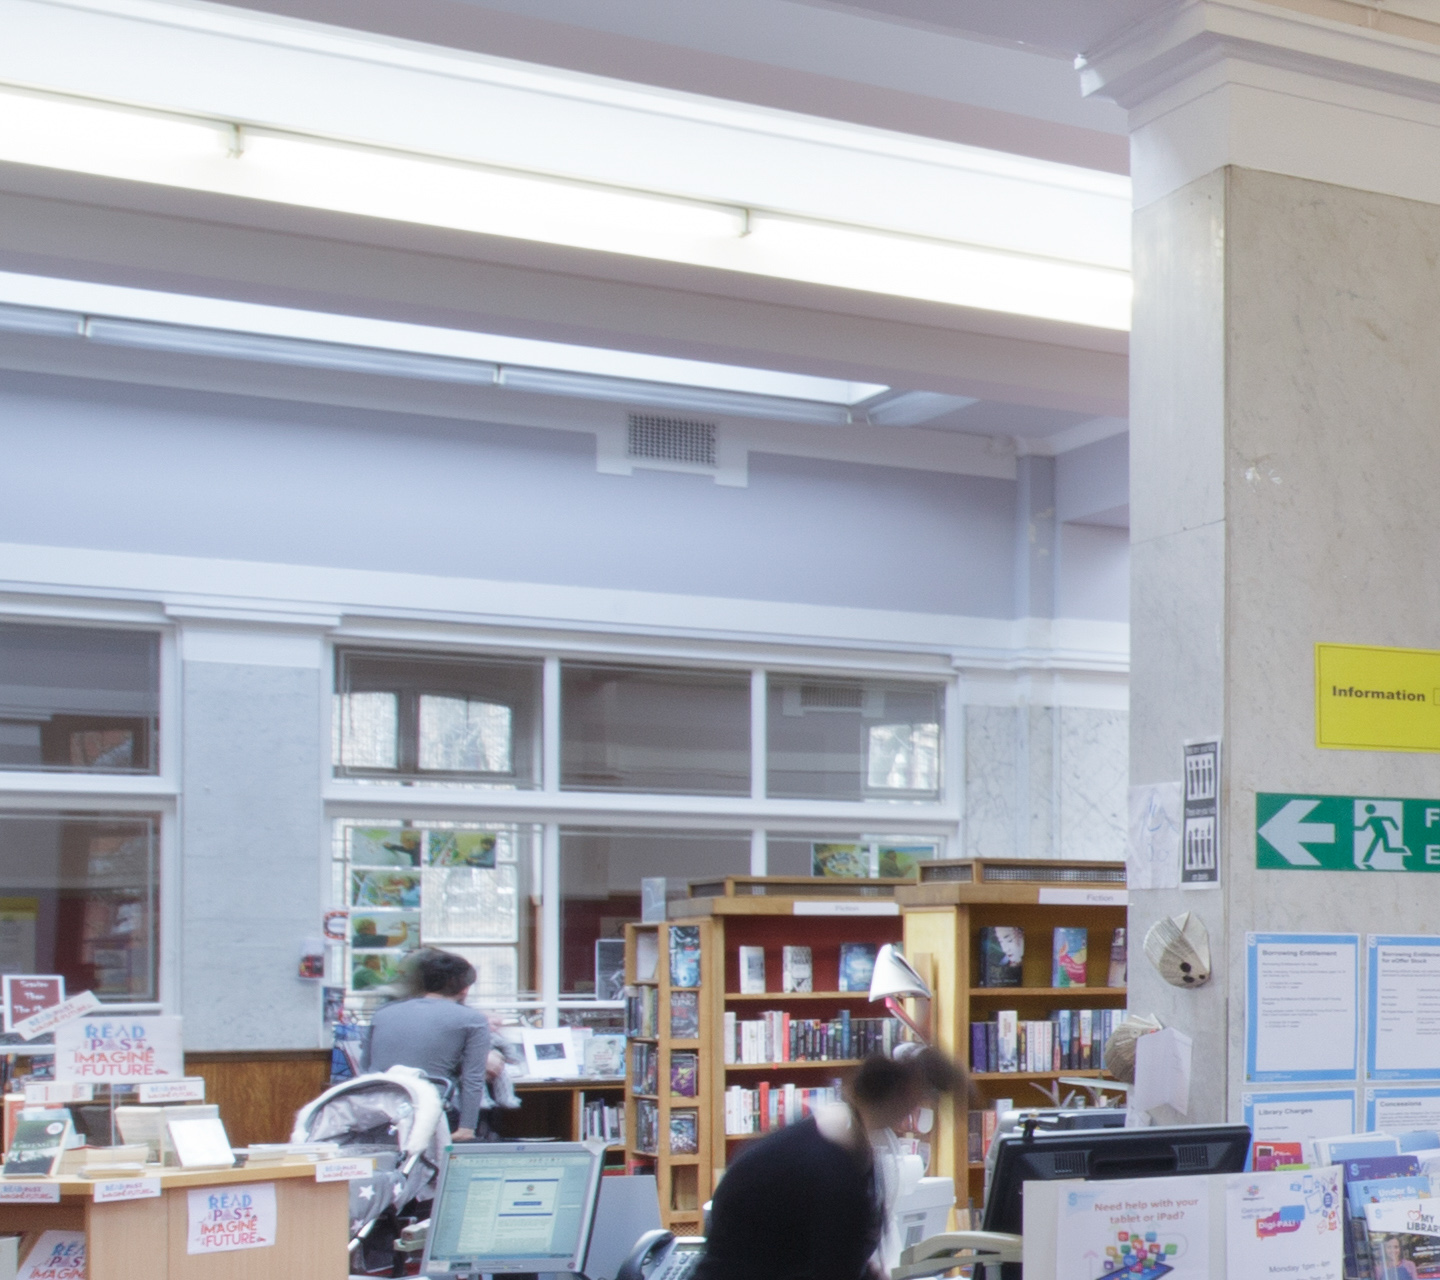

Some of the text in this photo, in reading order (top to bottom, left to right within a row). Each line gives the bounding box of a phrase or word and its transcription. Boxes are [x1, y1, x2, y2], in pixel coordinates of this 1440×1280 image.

[1331, 685, 1426, 703] Information
[1087, 894, 1114, 902] Fiction
[1262, 950, 1298, 958] Borrowing
[85, 1023, 145, 1039] READ
[74, 1051, 155, 1064] IMAGINE
[82, 1064, 153, 1076] FUTURE
[209, 1194, 252, 1209] READ
[1095, 1199, 1199, 1211] Need help with your
[1110, 1214, 1140, 1224] tablet
[1157, 1211, 1185, 1221] iPad?
[1421, 1215, 1435, 1223] MY
[201, 1220, 257, 1235] IMAGINE
[206, 1232, 256, 1247] FUTURE
[52, 1242, 85, 1257] REA
[30, 1268, 85, 1279] IMAGIN
[1268, 1265, 1299, 1273] Monday
